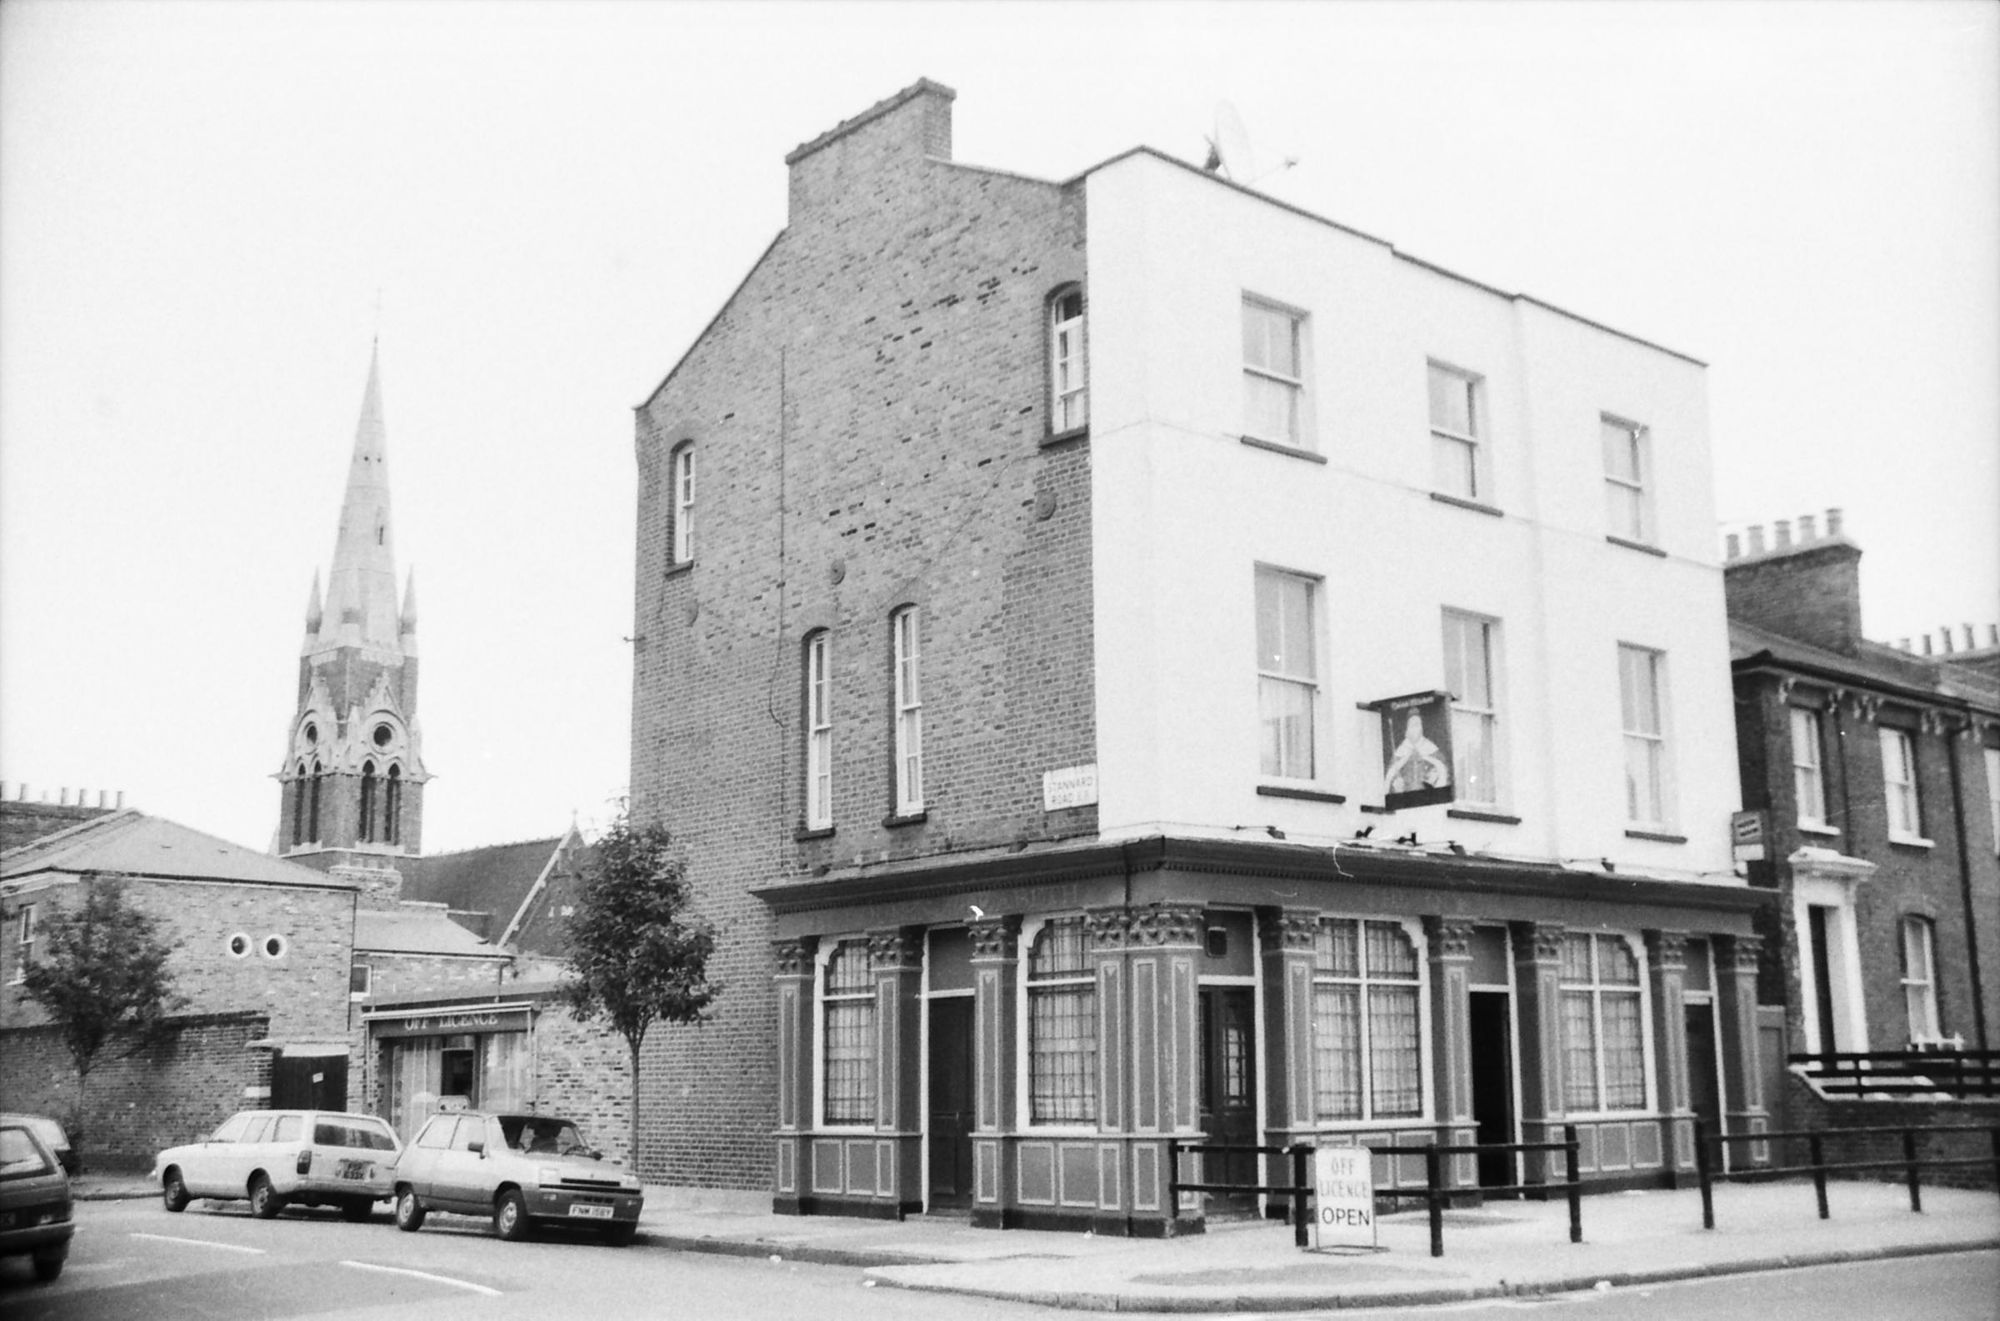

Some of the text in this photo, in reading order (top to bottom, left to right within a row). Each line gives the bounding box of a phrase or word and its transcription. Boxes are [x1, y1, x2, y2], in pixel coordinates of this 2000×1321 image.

[1048, 776, 1094, 791] STANNARD
[1051, 792, 1074, 805] ROAD
[404, 1013, 499, 1031] OFF LICENCE
[1331, 1157, 1356, 1176] OFF
[1319, 1180, 1368, 1198] LICENCE
[1321, 1206, 1370, 1226] OPEN
